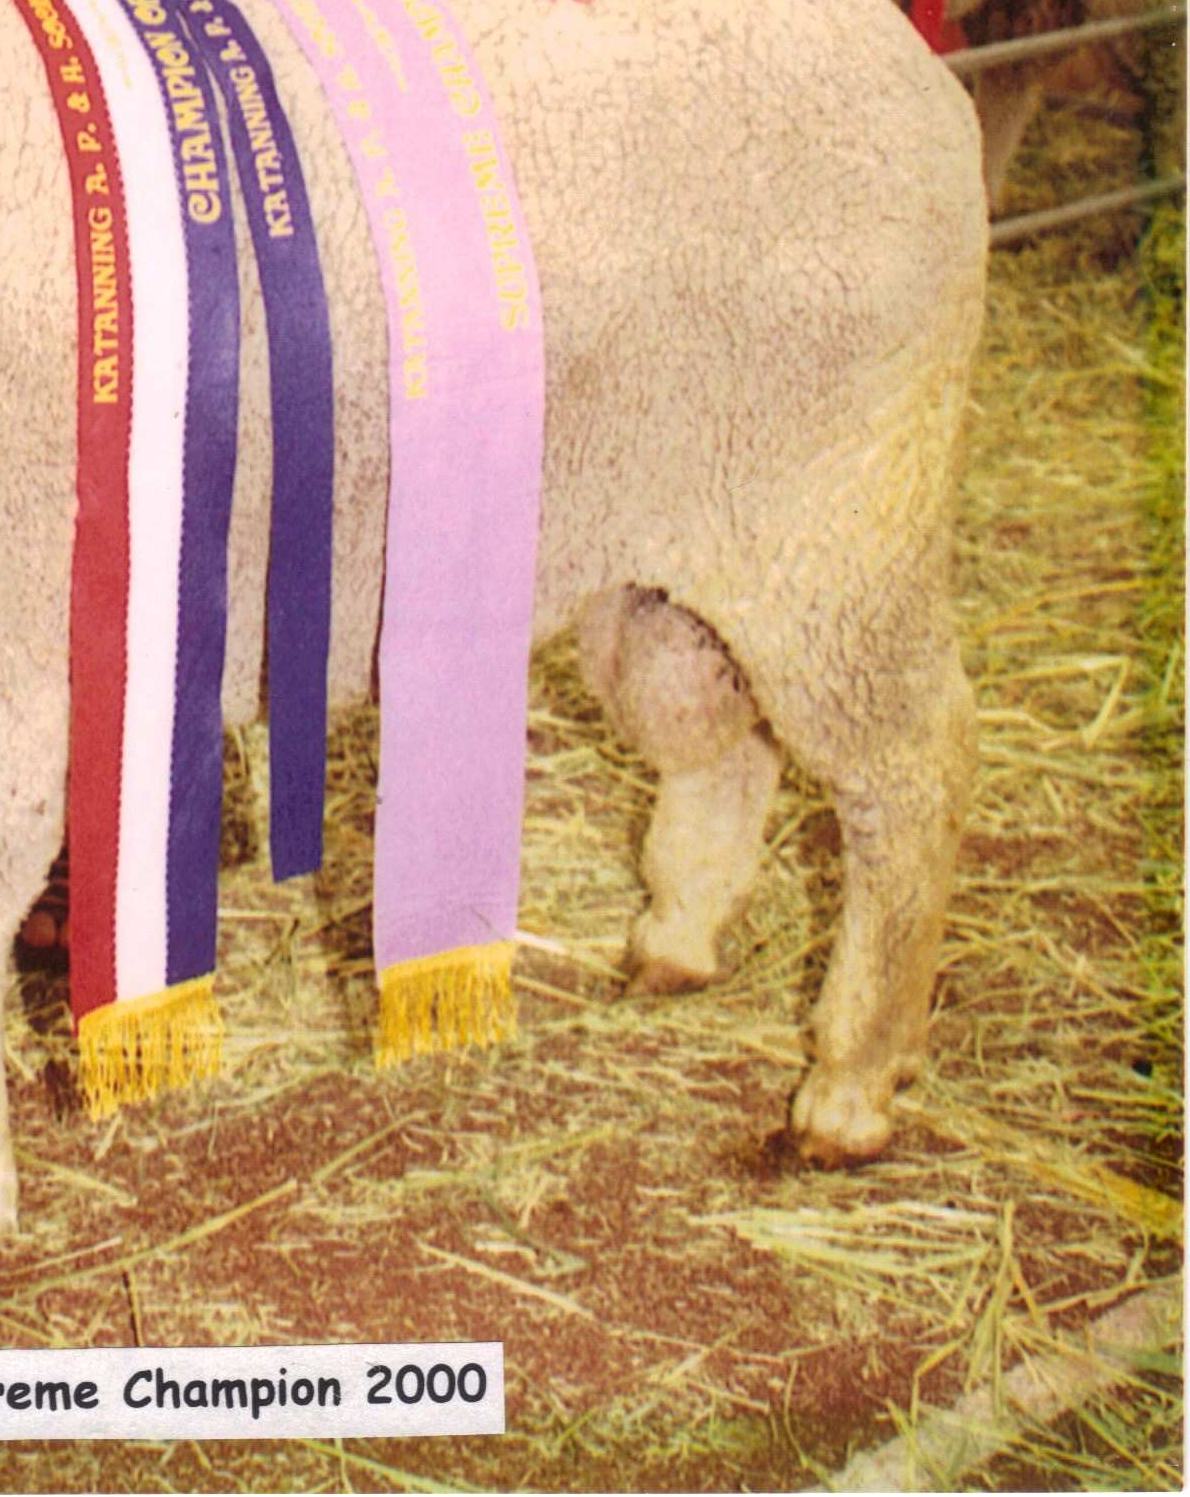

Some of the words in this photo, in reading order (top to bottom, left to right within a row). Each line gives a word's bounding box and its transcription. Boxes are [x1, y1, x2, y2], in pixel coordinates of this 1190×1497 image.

[66, 89, 91, 114] &
[77, 121, 103, 153] P.
[145, 31, 223, 225] CHAMPION
[229, 69, 294, 238] KATANNING
[88, 207, 119, 403] KATANNING
[461, 129, 530, 333] SUPREME
